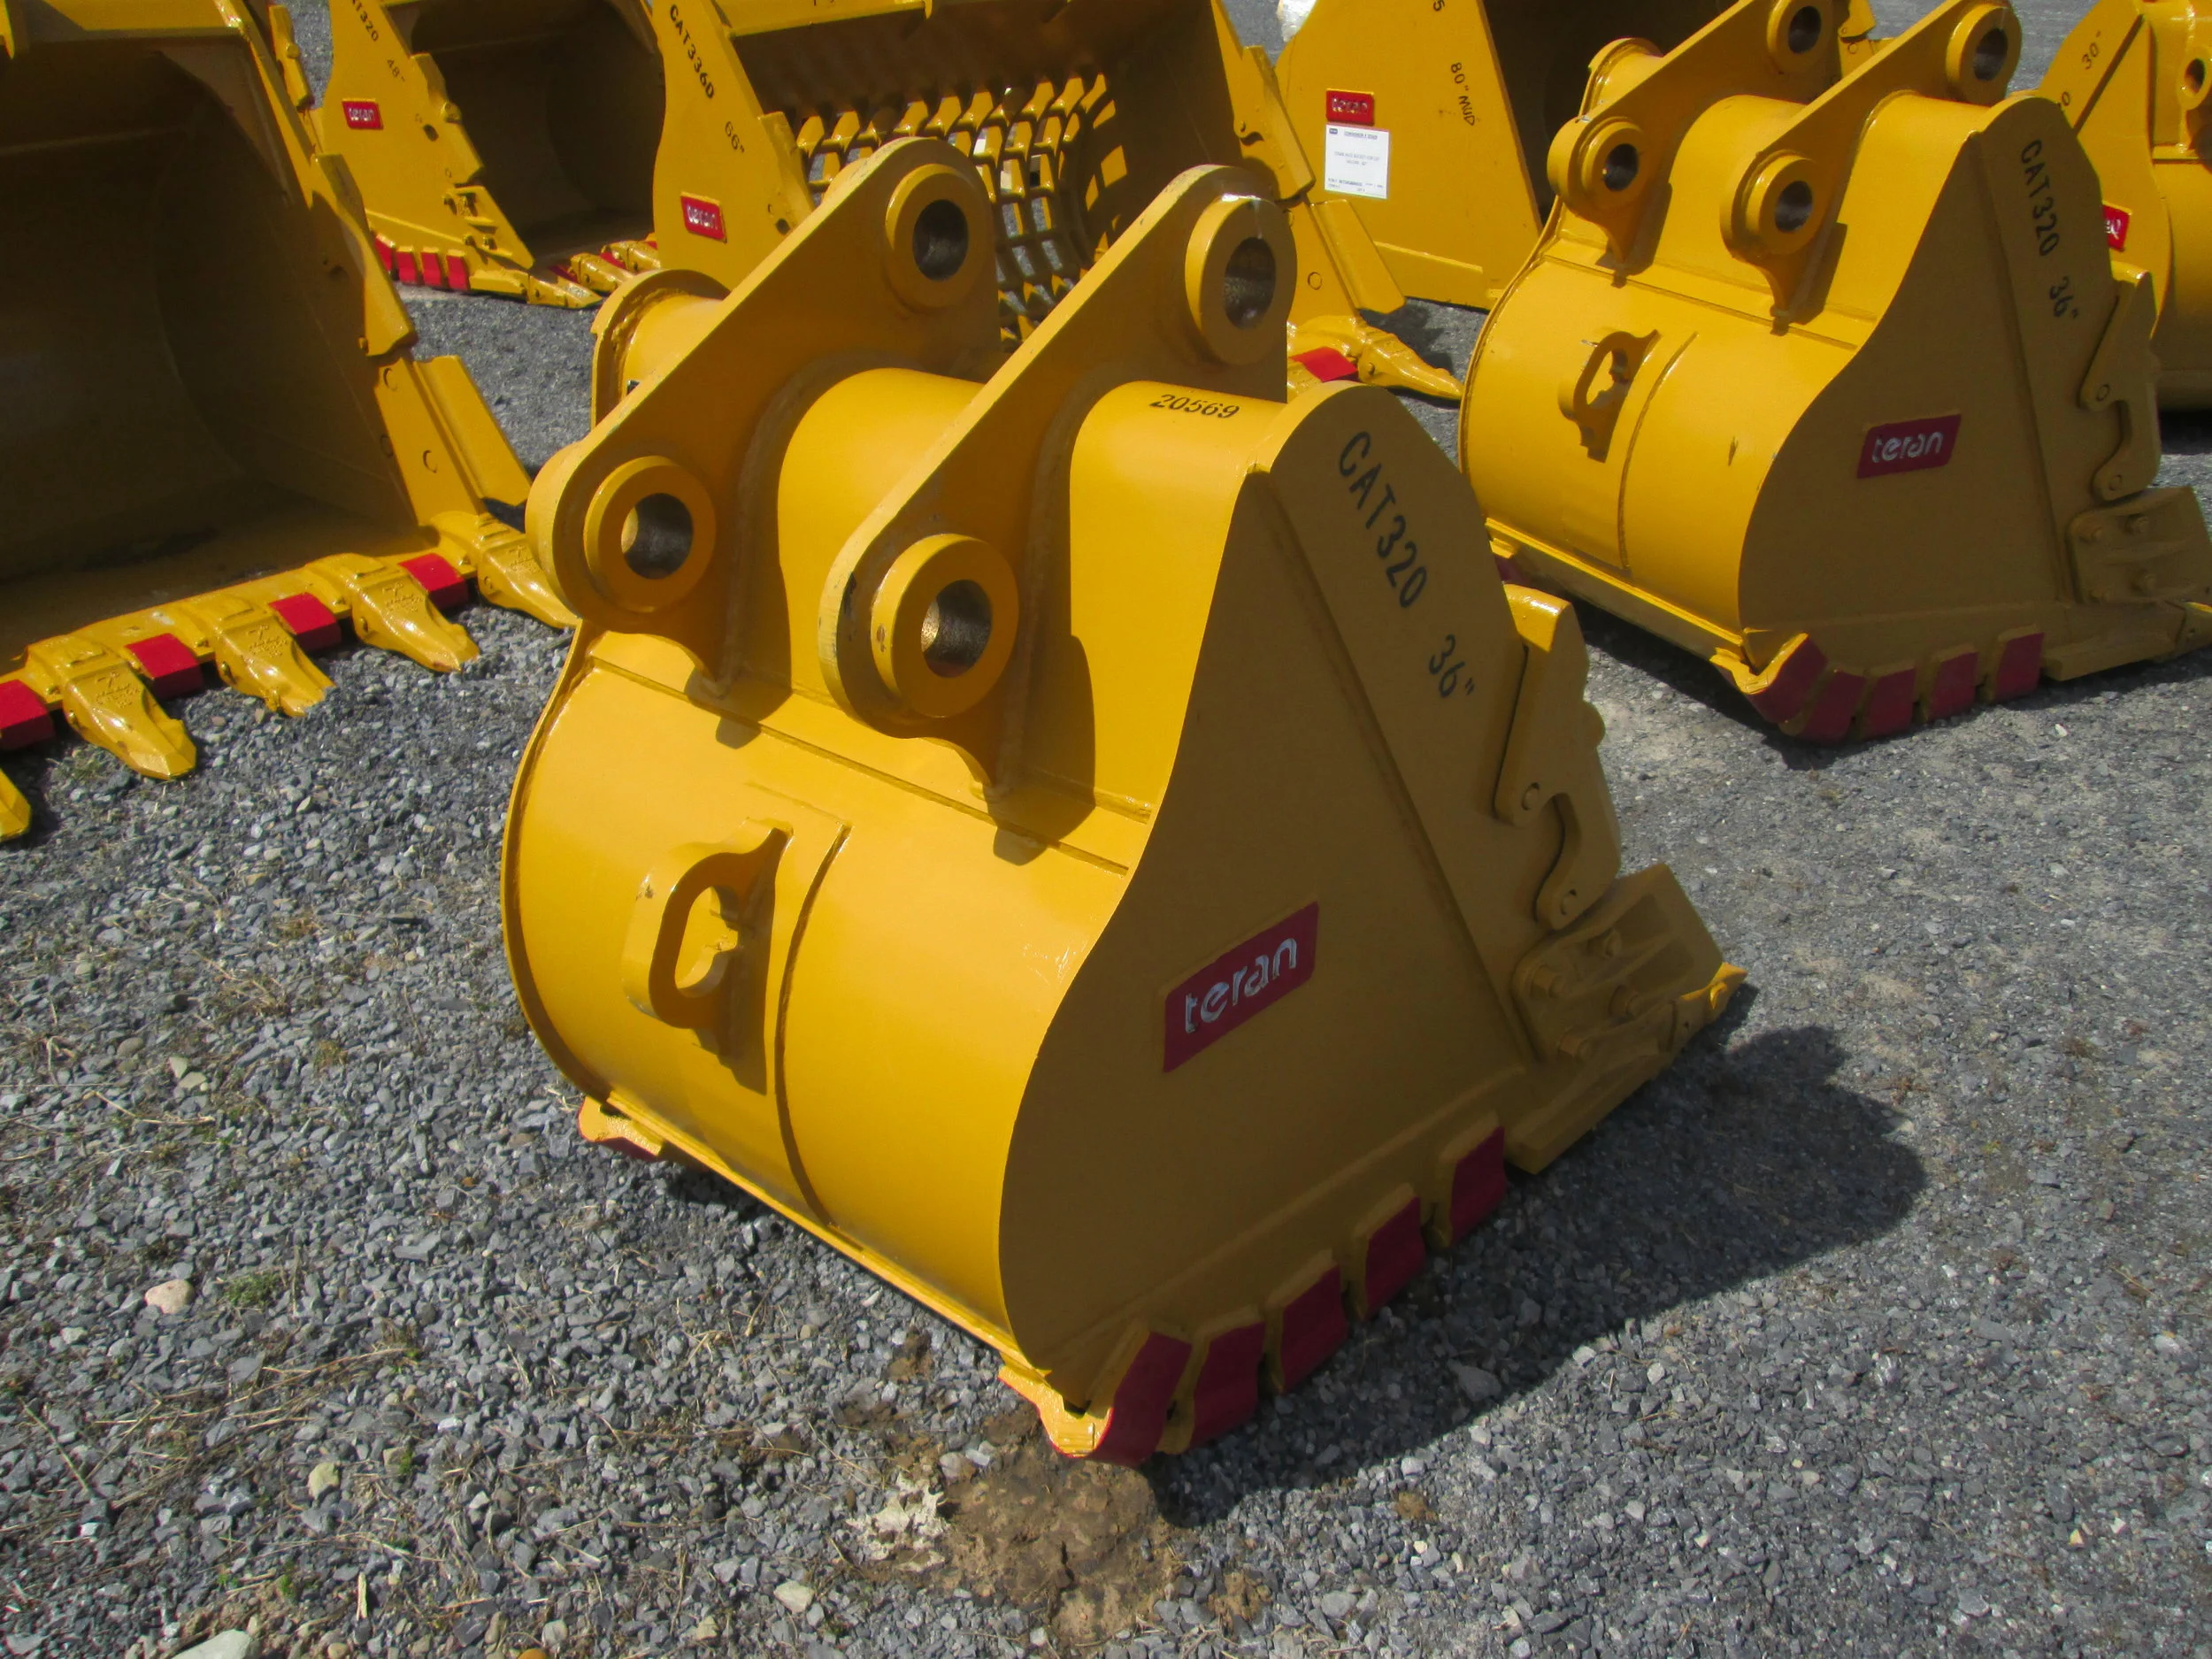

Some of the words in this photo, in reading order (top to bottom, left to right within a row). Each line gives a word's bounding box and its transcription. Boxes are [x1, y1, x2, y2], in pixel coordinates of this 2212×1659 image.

[670, 4, 715, 99] CAT336D
[725, 120, 745, 153] 66"
[1458, 95, 1476, 126] MUD
[2021, 139, 2060, 257] CAT320
[2049, 275, 2078, 319] 36"
[1149, 394, 1240, 419] 20569
[1871, 431, 1944, 464] teran
[1339, 431, 1428, 609] CAT320
[1428, 634, 1475, 698] 36"
[1185, 938, 1298, 1034] teran
